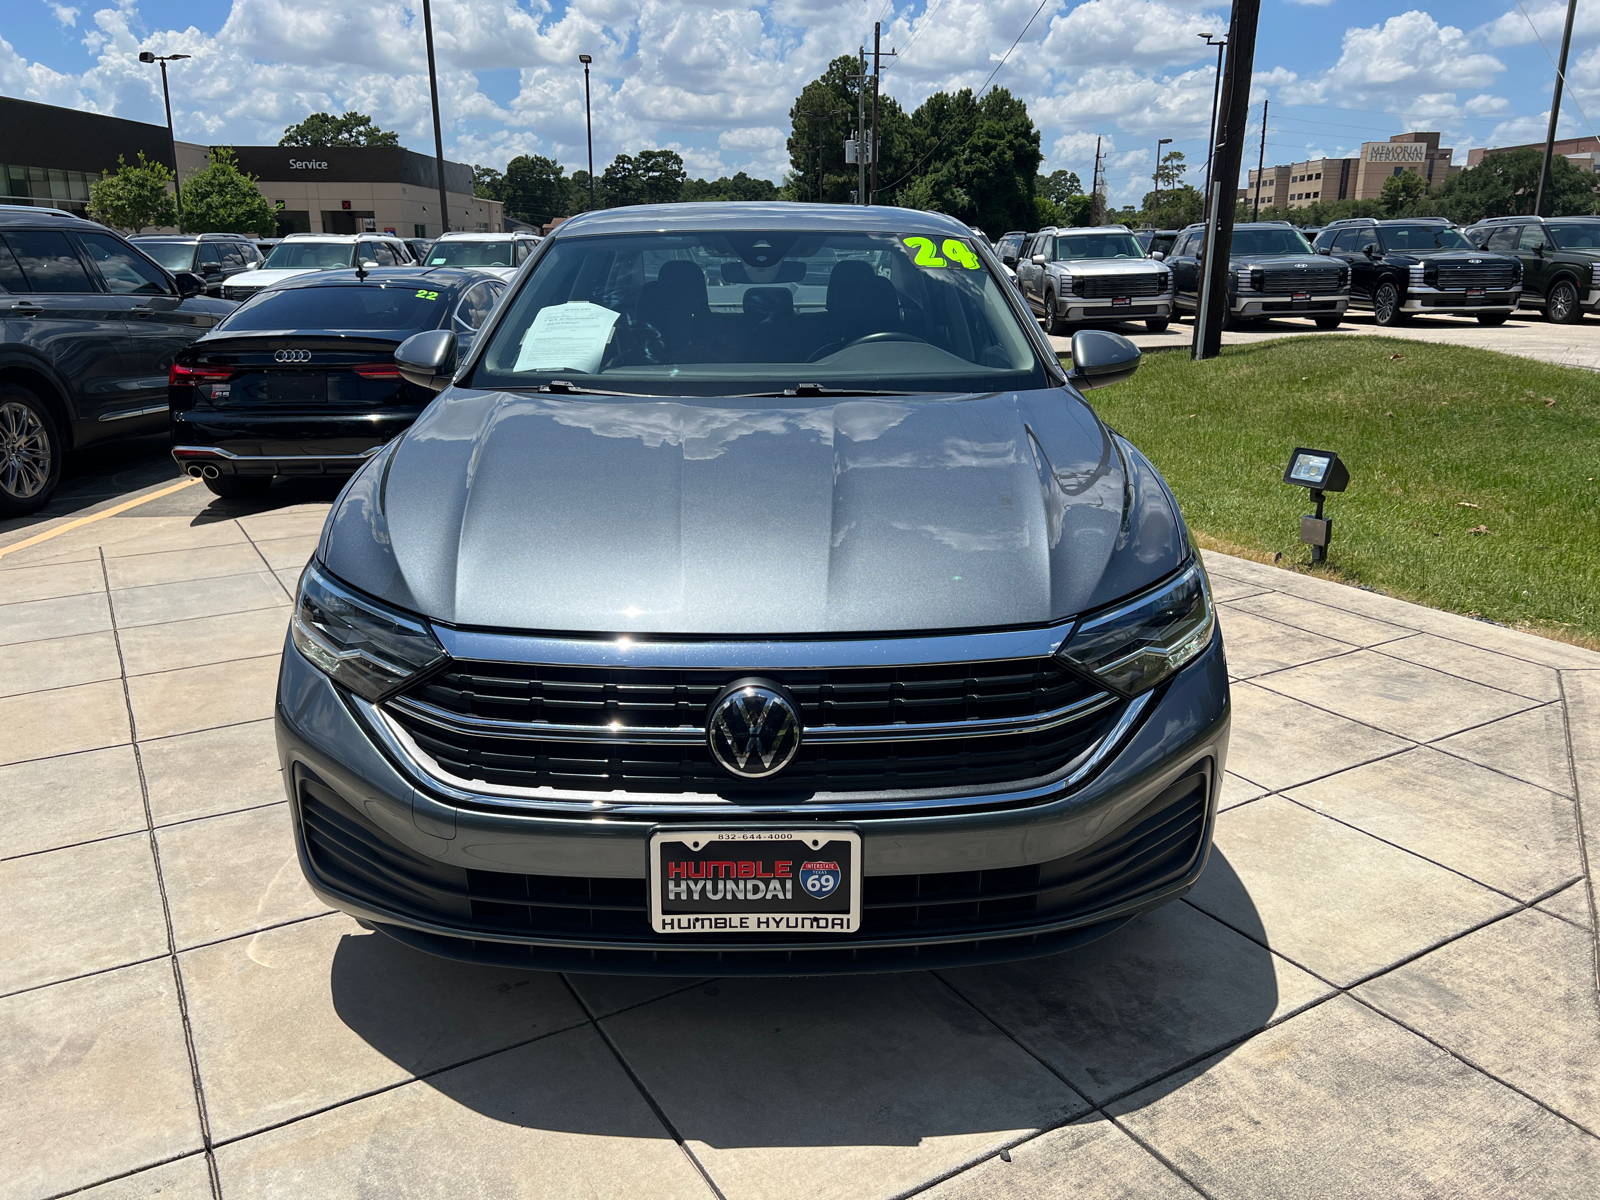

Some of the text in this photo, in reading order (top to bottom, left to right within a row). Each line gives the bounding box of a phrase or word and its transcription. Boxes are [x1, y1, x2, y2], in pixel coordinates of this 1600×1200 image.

[1371, 145, 1424, 155] MEMORIAL
[1370, 153, 1424, 162] HERMANN
[289, 159, 328, 170] Service
[903, 236, 980, 270] 24
[415, 290, 439, 301] 22
[668, 861, 793, 878] HUMBLE
[668, 879, 793, 900] HYUNDAI
[806, 874, 835, 892] 69
[662, 917, 850, 930] HUMBLE HYUNDAI
